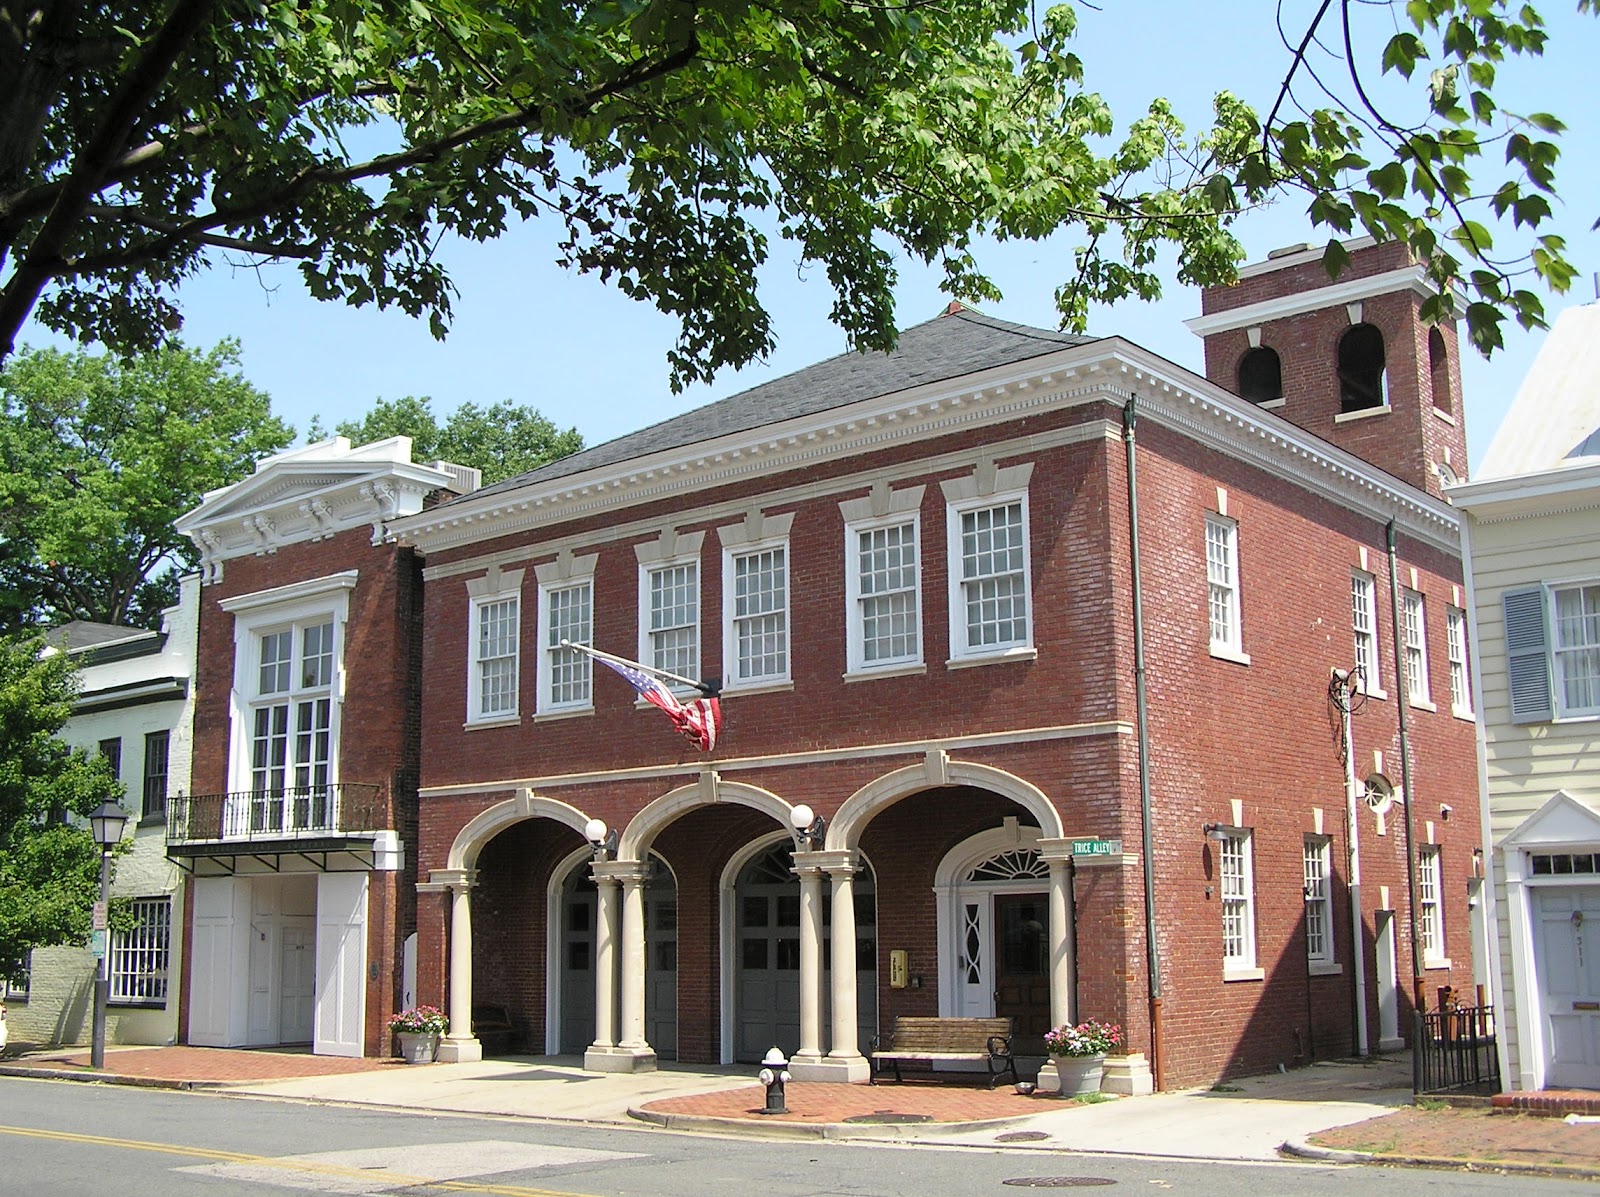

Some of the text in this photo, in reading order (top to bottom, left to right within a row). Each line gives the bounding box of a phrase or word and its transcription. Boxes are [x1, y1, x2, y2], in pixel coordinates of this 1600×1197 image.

[1074, 842, 1110, 853] TRICE ALLEY
[1576, 936, 1584, 967] 311
